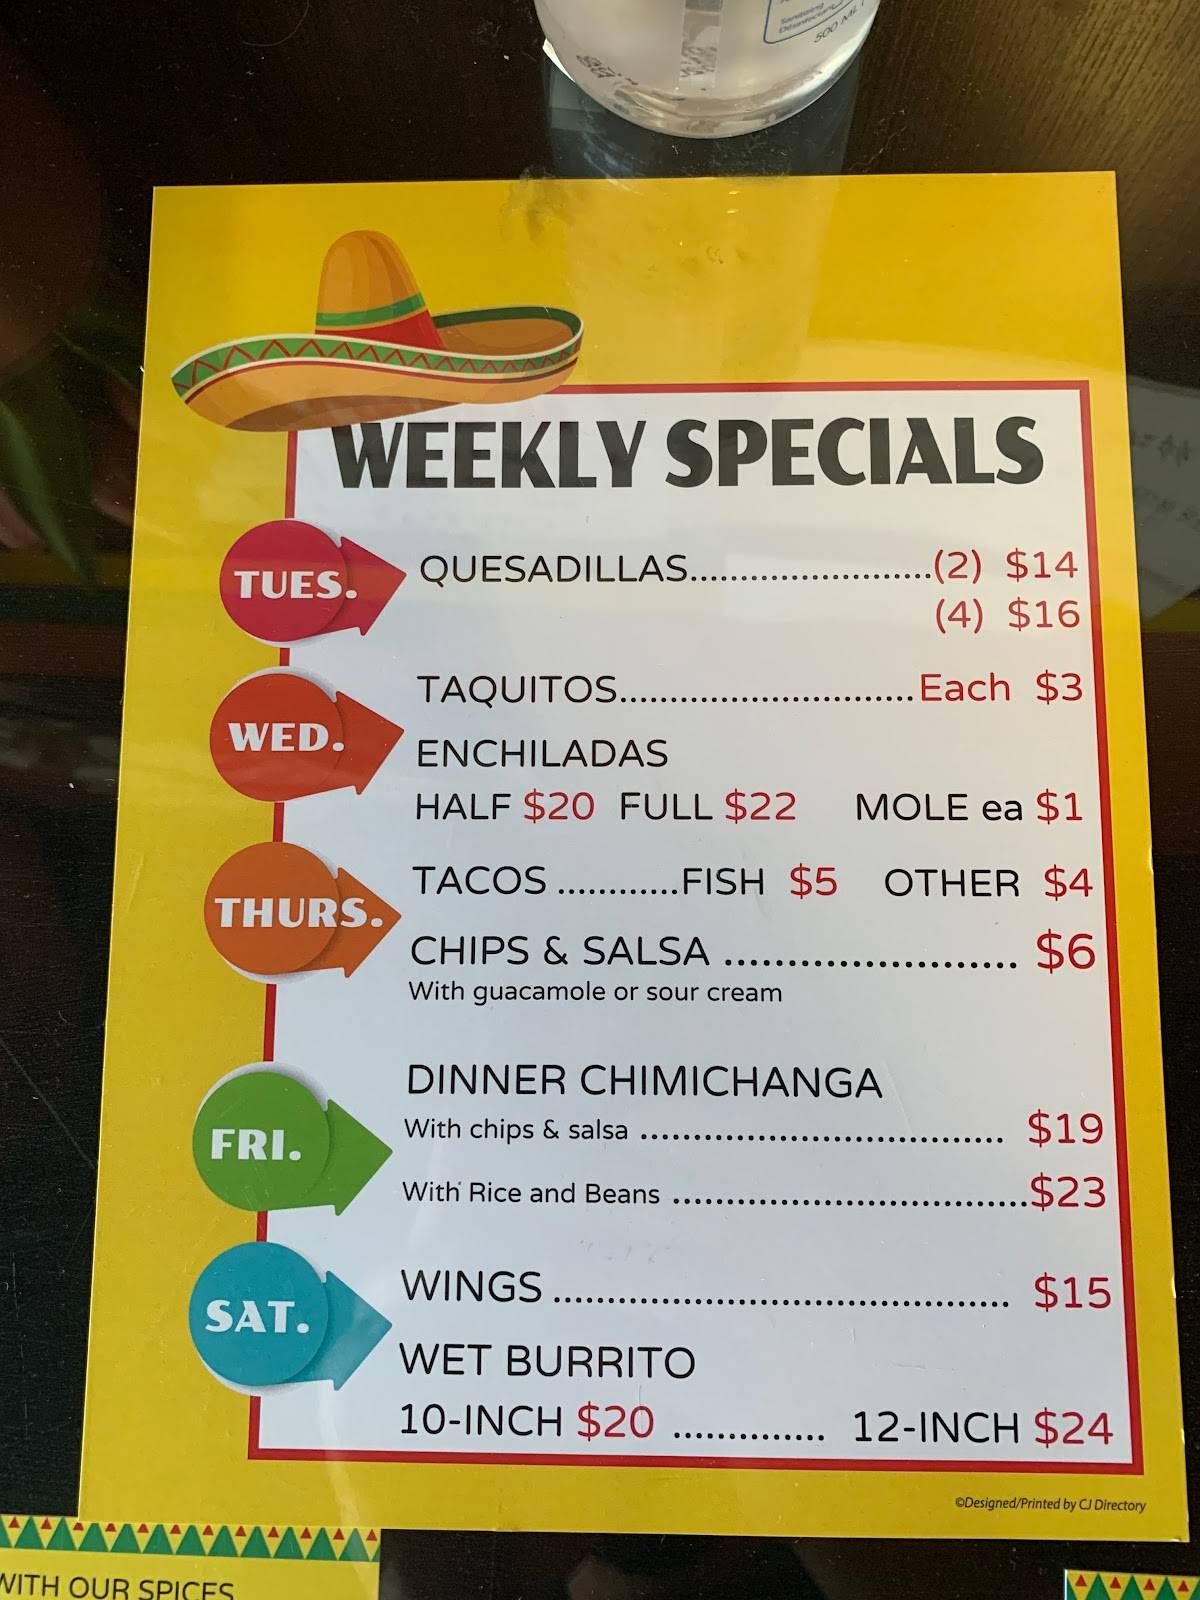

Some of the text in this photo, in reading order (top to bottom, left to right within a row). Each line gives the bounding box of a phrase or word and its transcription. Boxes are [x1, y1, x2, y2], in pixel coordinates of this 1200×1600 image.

[814, 21, 839, 43] 500
[331, 416, 1044, 488] WEEKLY SPECIALS
[934, 549, 982, 584] (2)
[1006, 548, 1078, 580] $14
[234, 570, 358, 600] TUES.
[936, 597, 1080, 634] (4) $16
[921, 672, 1010, 702] Each
[1036, 669, 1083, 705] $3
[228, 722, 345, 752] WED.
[418, 738, 668, 768] ENCHILADAS
[416, 788, 1083, 825] HALF $20 FULL $22 MOLE ea $1
[412, 863, 1093, 901] TACOS FISH $5 OTHER $4
[215, 897, 384, 928] THURS.
[411, 928, 1096, 974] CHIPS & SALSA $6
[409, 981, 782, 1006] With guacamole or sour cream
[407, 1064, 883, 1099] DINNER CHIMICHANGA
[211, 1128, 302, 1161] FRI.
[404, 1109, 1103, 1147] With chips & salsa $19
[402, 1172, 1106, 1211] With Rice and Beans $23
[401, 1269, 1111, 1312] WINGS $15
[205, 1299, 310, 1334] SAT.
[399, 1343, 696, 1379] WET BURRITO
[400, 1401, 1113, 1449] 10-INCH $20 12-INCH $24
[1063, 1498, 1076, 1513] by
[1079, 1499, 1092, 1511] CJ
[1094, 1499, 1147, 1513] Directory
[0, 1573, 59, 1597] WITH
[69, 1577, 130, 1600] OUR
